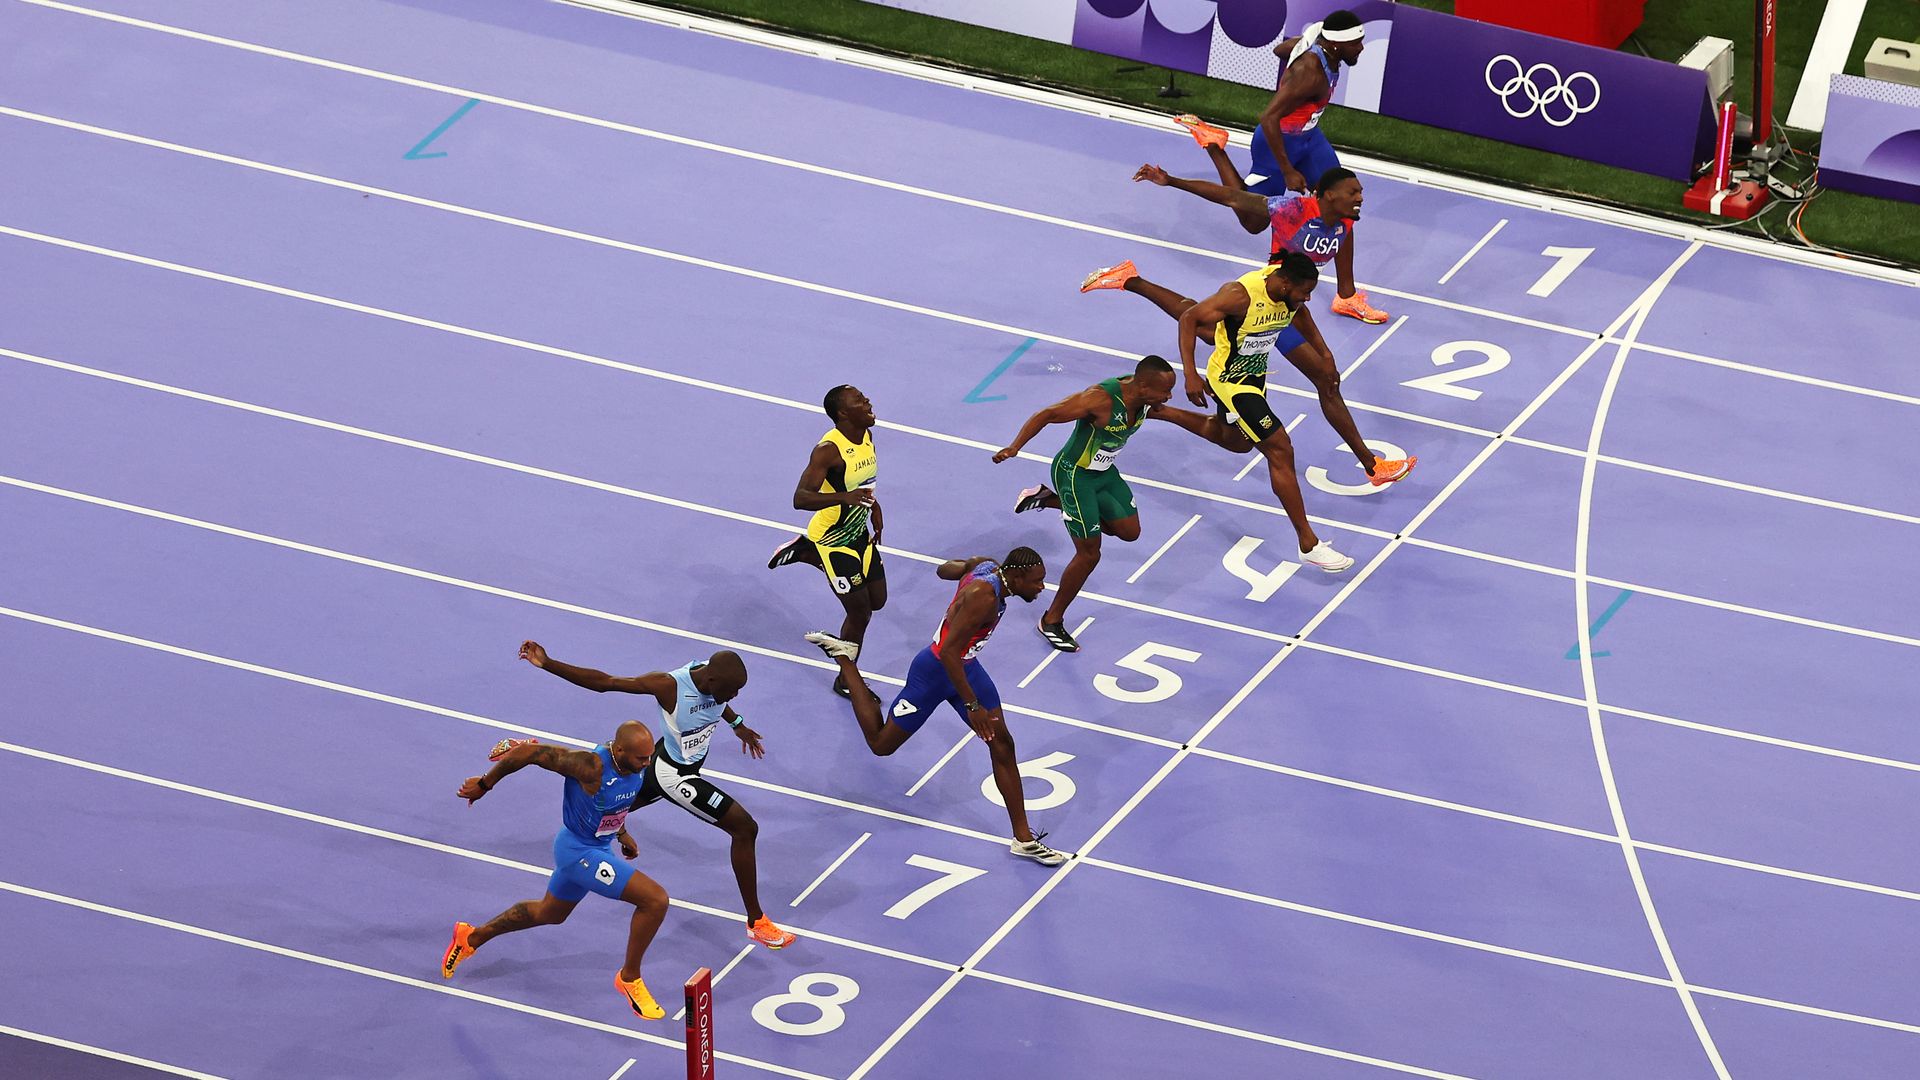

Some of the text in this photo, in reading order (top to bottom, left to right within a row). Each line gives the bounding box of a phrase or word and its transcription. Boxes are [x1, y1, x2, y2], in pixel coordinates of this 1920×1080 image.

[1303, 233, 1339, 254] USA
[1526, 246, 1596, 298] 1
[1252, 311, 1290, 326] JAMAICA
[1399, 341, 1512, 400] 2
[1304, 439, 1408, 496] 3
[838, 579, 847, 590] 6
[1222, 535, 1303, 603] 4
[1092, 641, 1203, 704] 5
[615, 790, 636, 801] ITALIA
[680, 787, 691, 798] 8
[980, 750, 1077, 811] 6
[883, 854, 989, 920] 7
[751, 972, 860, 1036] 8
[700, 1014, 710, 1078] OMEGA
